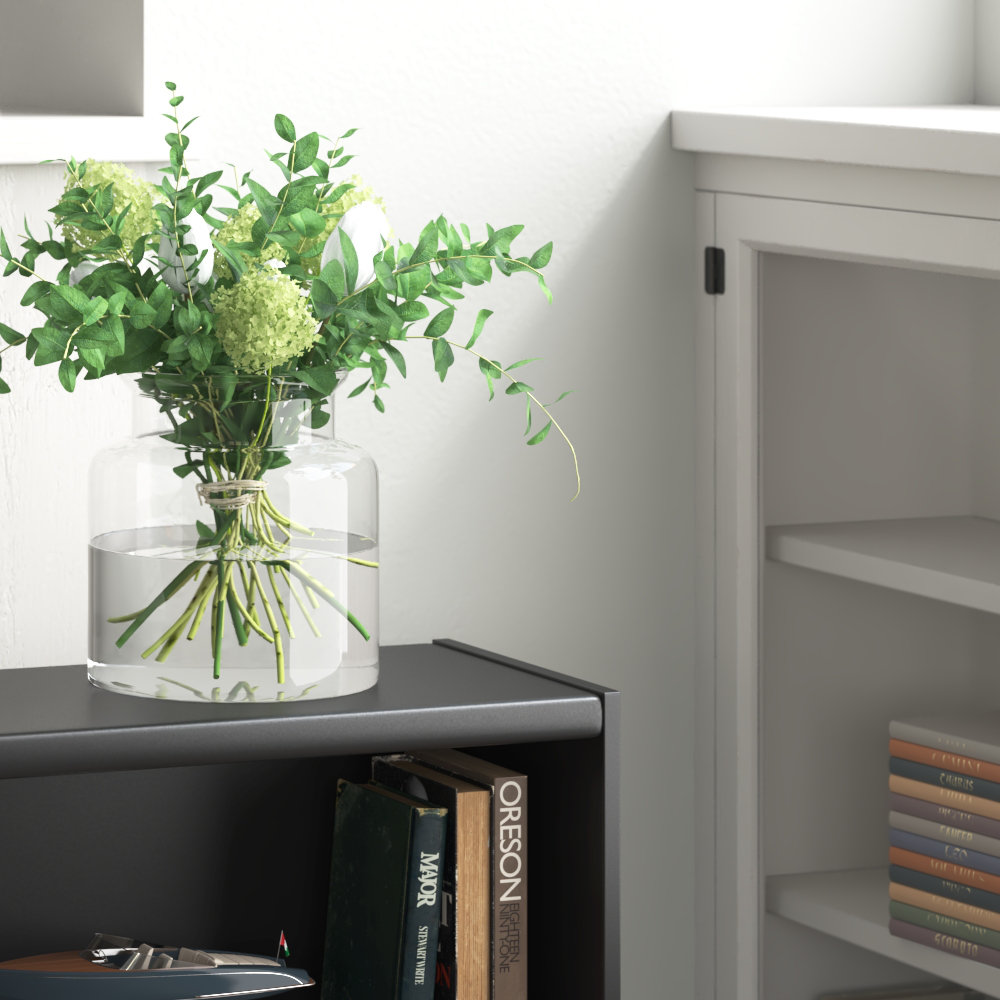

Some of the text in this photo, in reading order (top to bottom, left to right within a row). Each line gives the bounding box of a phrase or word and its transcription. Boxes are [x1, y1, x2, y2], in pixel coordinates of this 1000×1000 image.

[499, 780, 522, 901] ORESON
[416, 851, 439, 908] MAJOR
[509, 903, 520, 963] EIGHTEEN
